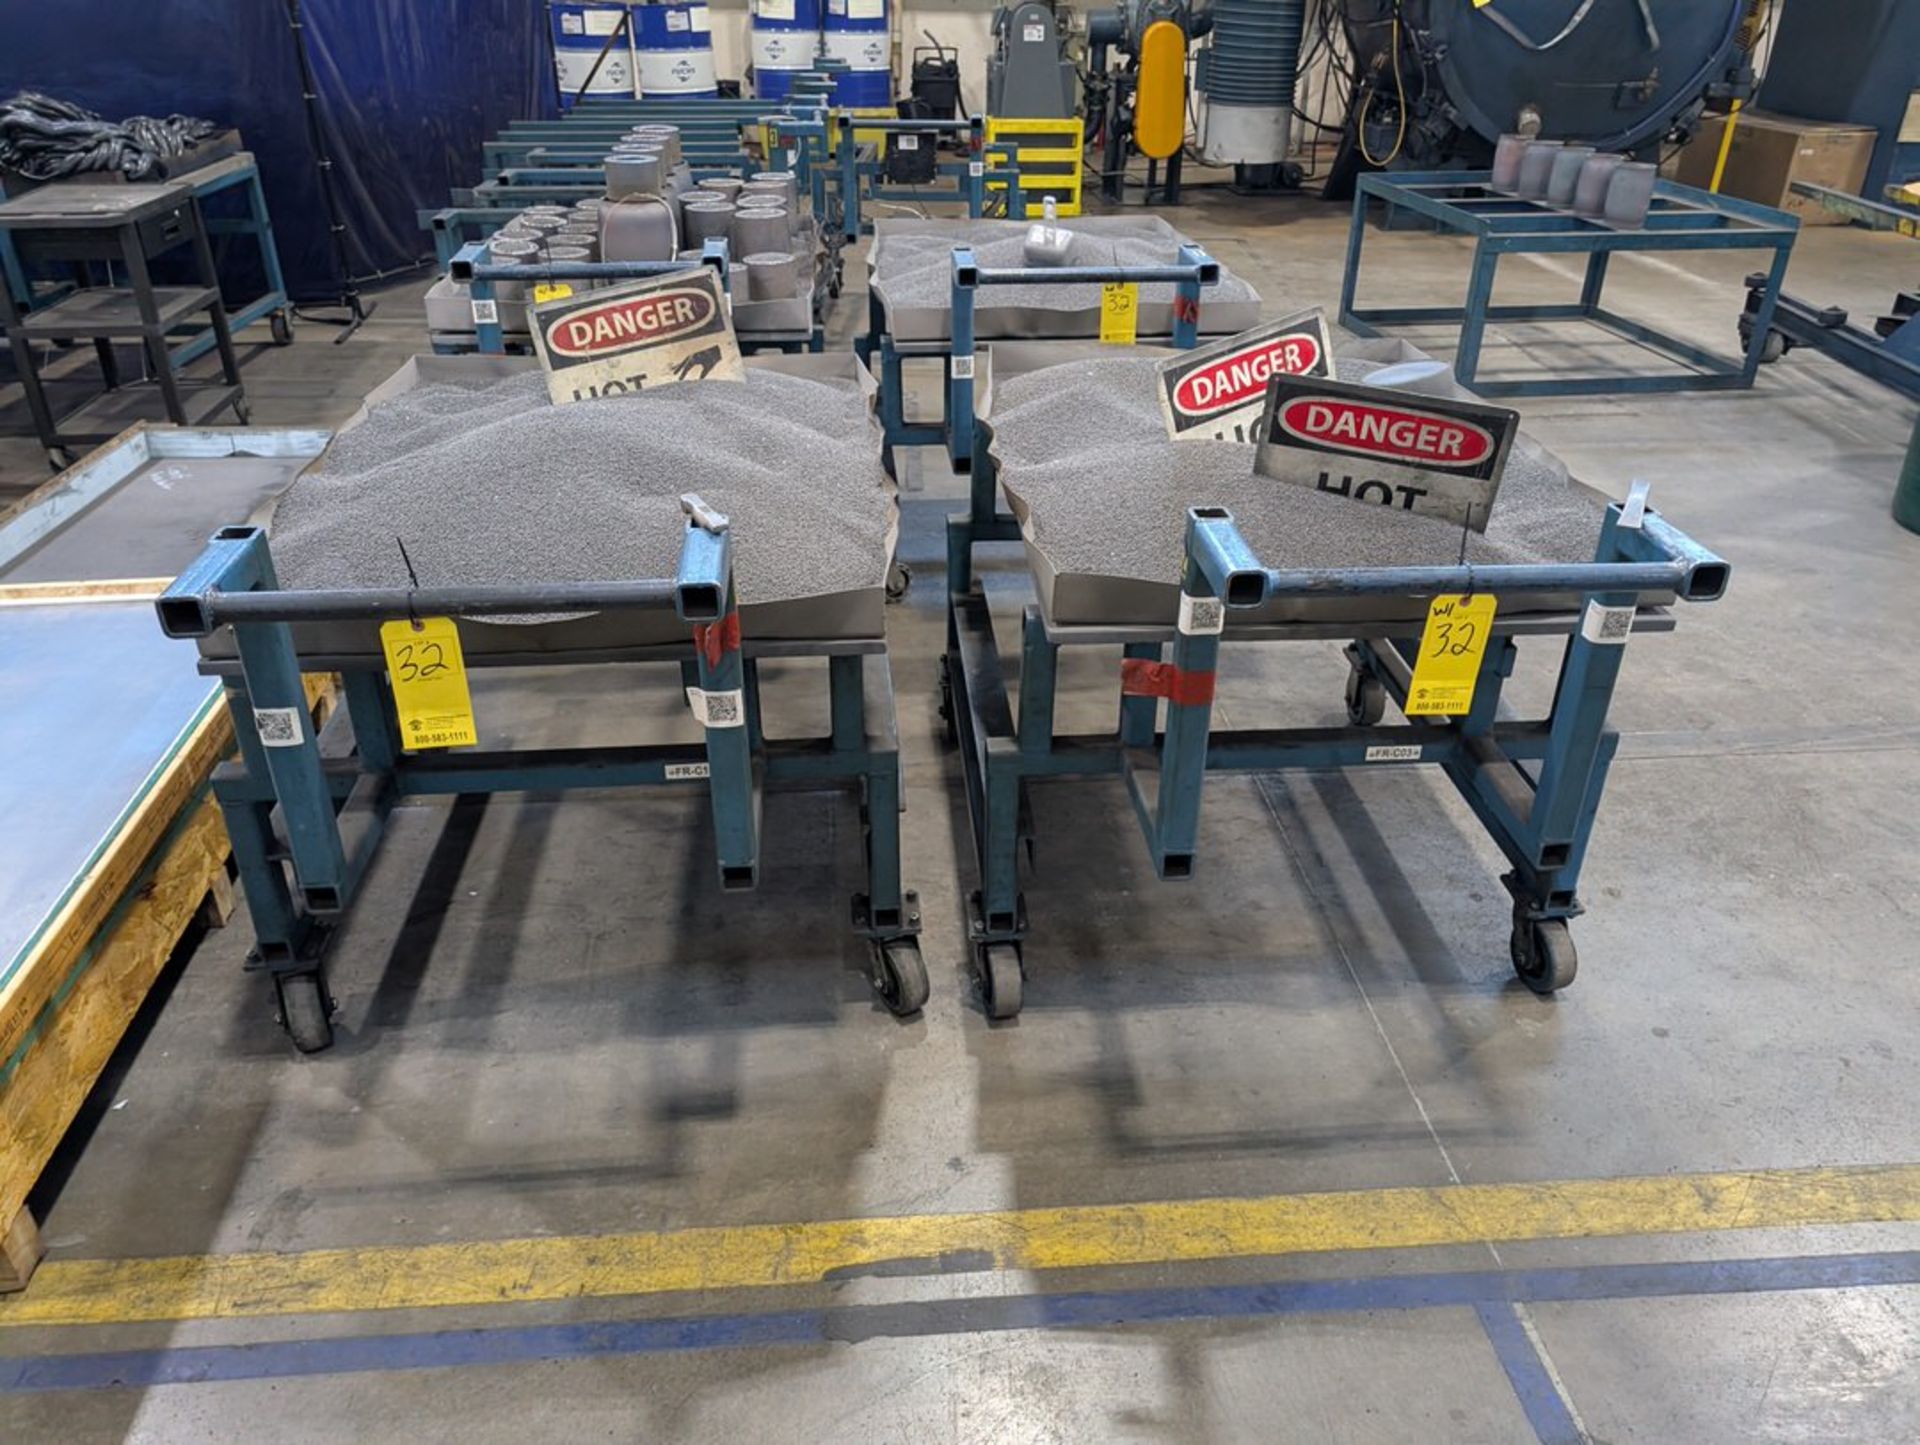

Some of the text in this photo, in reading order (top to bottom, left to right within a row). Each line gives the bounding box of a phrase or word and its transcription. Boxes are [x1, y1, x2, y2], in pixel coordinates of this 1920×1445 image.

[568, 298, 695, 348] DANGER
[1191, 343, 1303, 406] DANGER
[1304, 404, 1465, 456] DANGER
[1317, 471, 1428, 511] HOT
[396, 642, 450, 682] 32
[1431, 622, 1477, 658] 32
